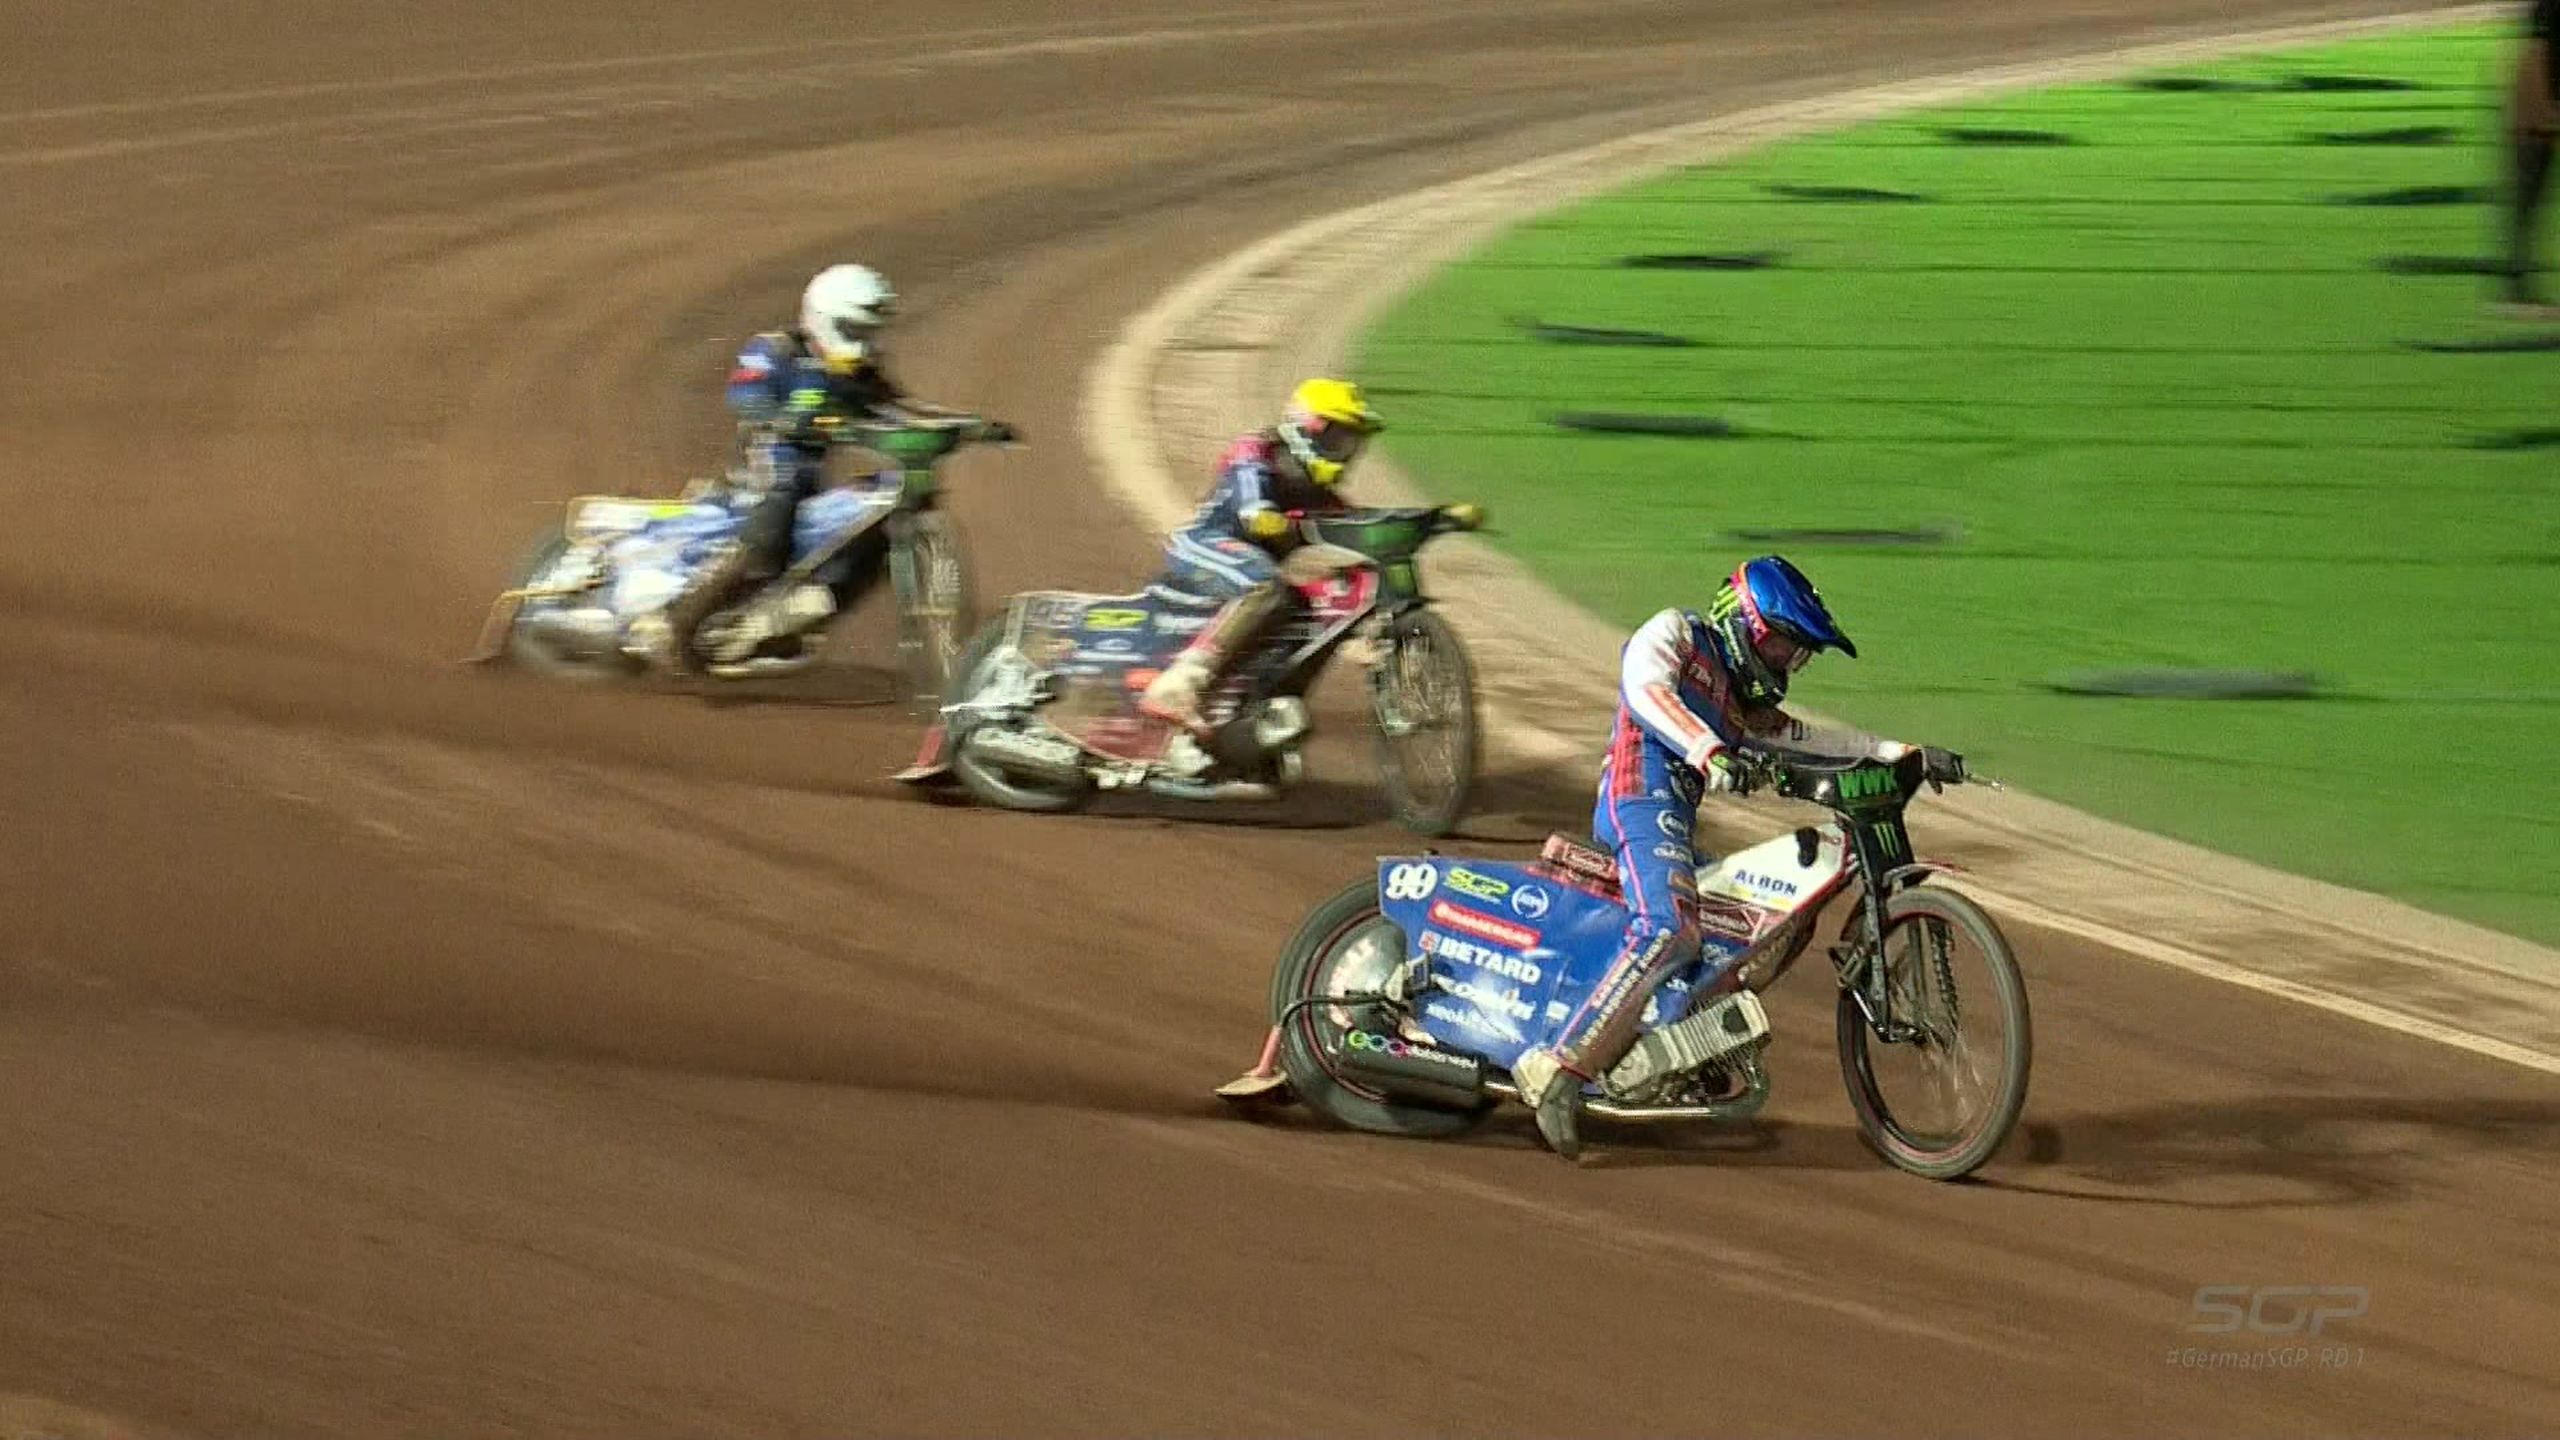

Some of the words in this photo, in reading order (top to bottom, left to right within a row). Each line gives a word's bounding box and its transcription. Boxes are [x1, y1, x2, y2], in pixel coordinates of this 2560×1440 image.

[1387, 863, 1438, 899] 99
[1735, 869, 1798, 895] ALBON
[1439, 936, 1541, 985] BETARD
